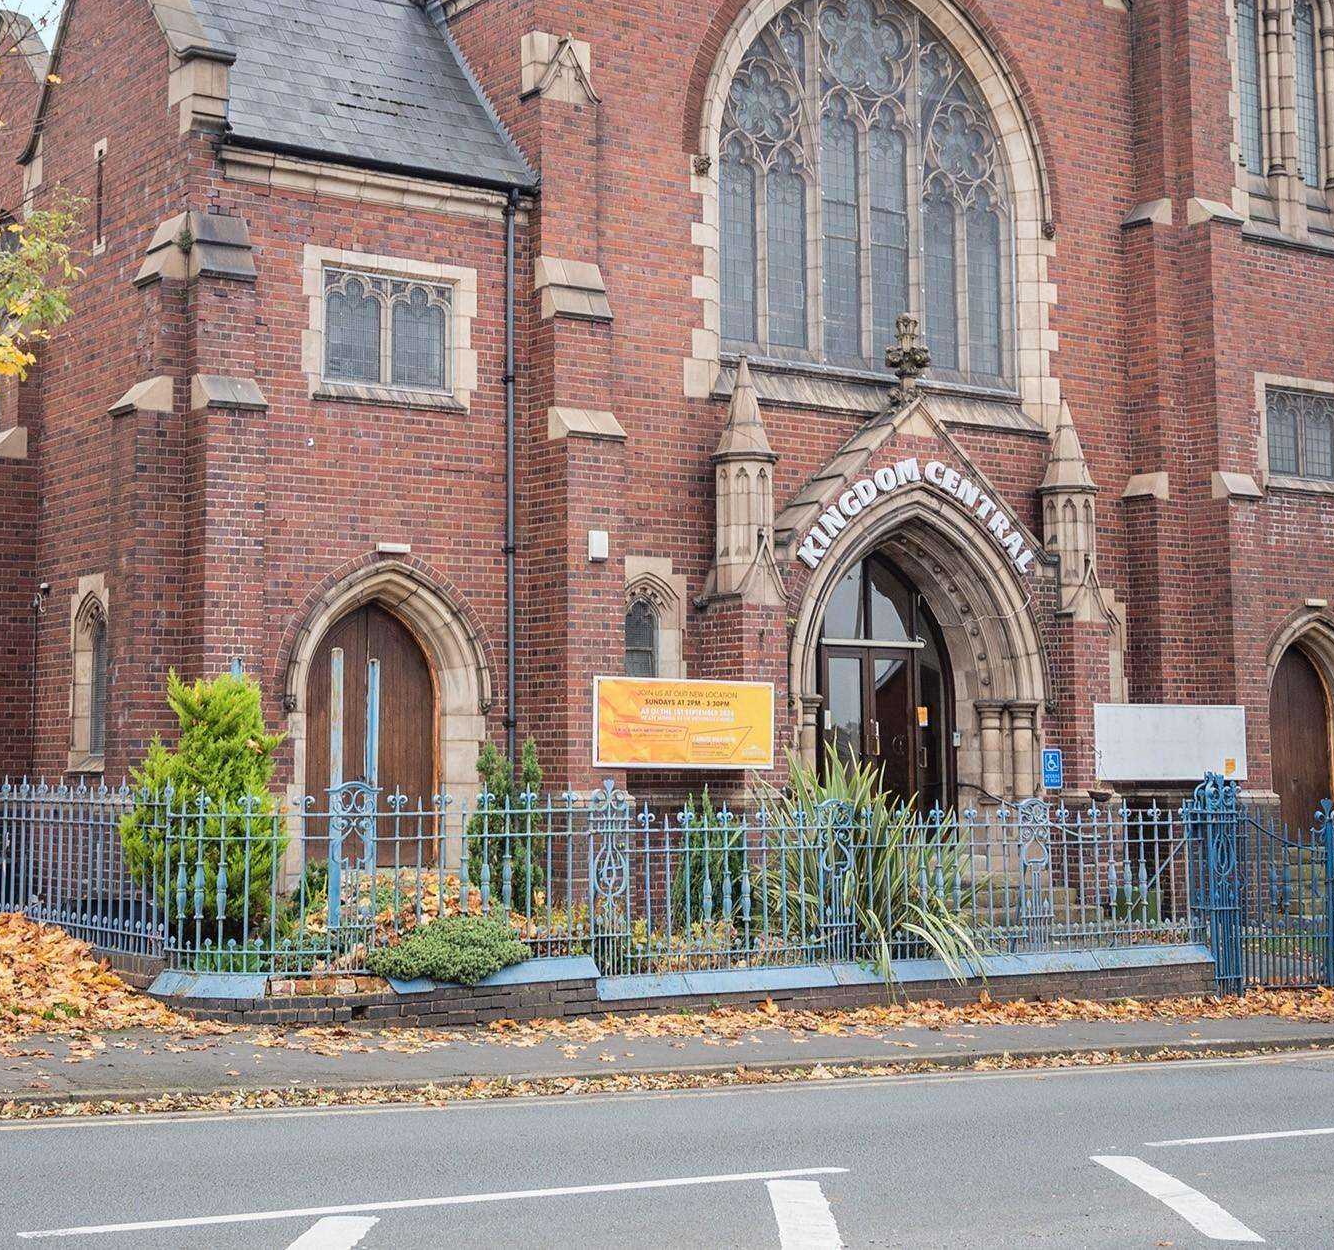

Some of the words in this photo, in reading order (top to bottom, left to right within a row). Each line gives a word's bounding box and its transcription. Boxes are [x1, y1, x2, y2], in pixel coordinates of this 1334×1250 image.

[797, 457, 921, 569] KINGDOM
[924, 460, 1035, 574] CENTRAL
[637, 689, 653, 697] JOIN
[689, 690, 703, 698] NEW
[705, 691, 738, 699] LOCATION
